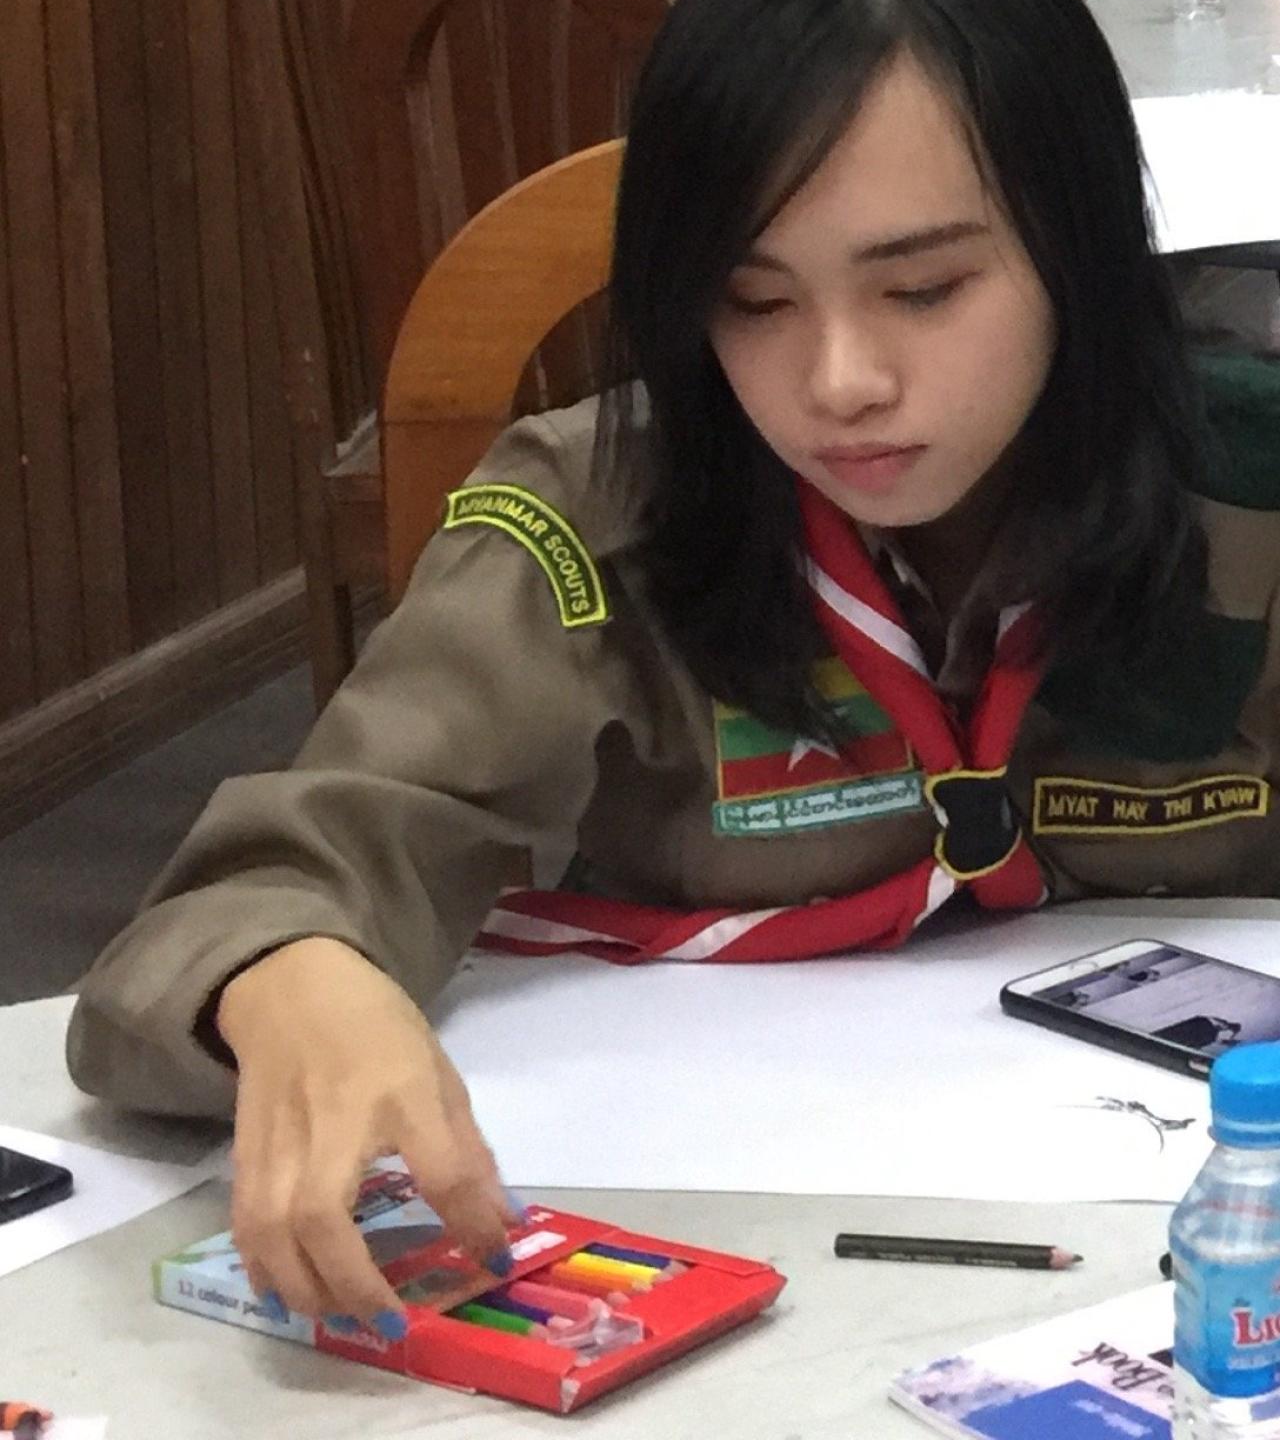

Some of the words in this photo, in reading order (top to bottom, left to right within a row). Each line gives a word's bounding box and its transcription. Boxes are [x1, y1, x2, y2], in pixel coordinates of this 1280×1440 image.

[457, 495, 549, 538] MYANMAR
[543, 534, 591, 614] SCOUTS
[1047, 794, 1099, 818] MYAT
[1162, 796, 1193, 820] THI
